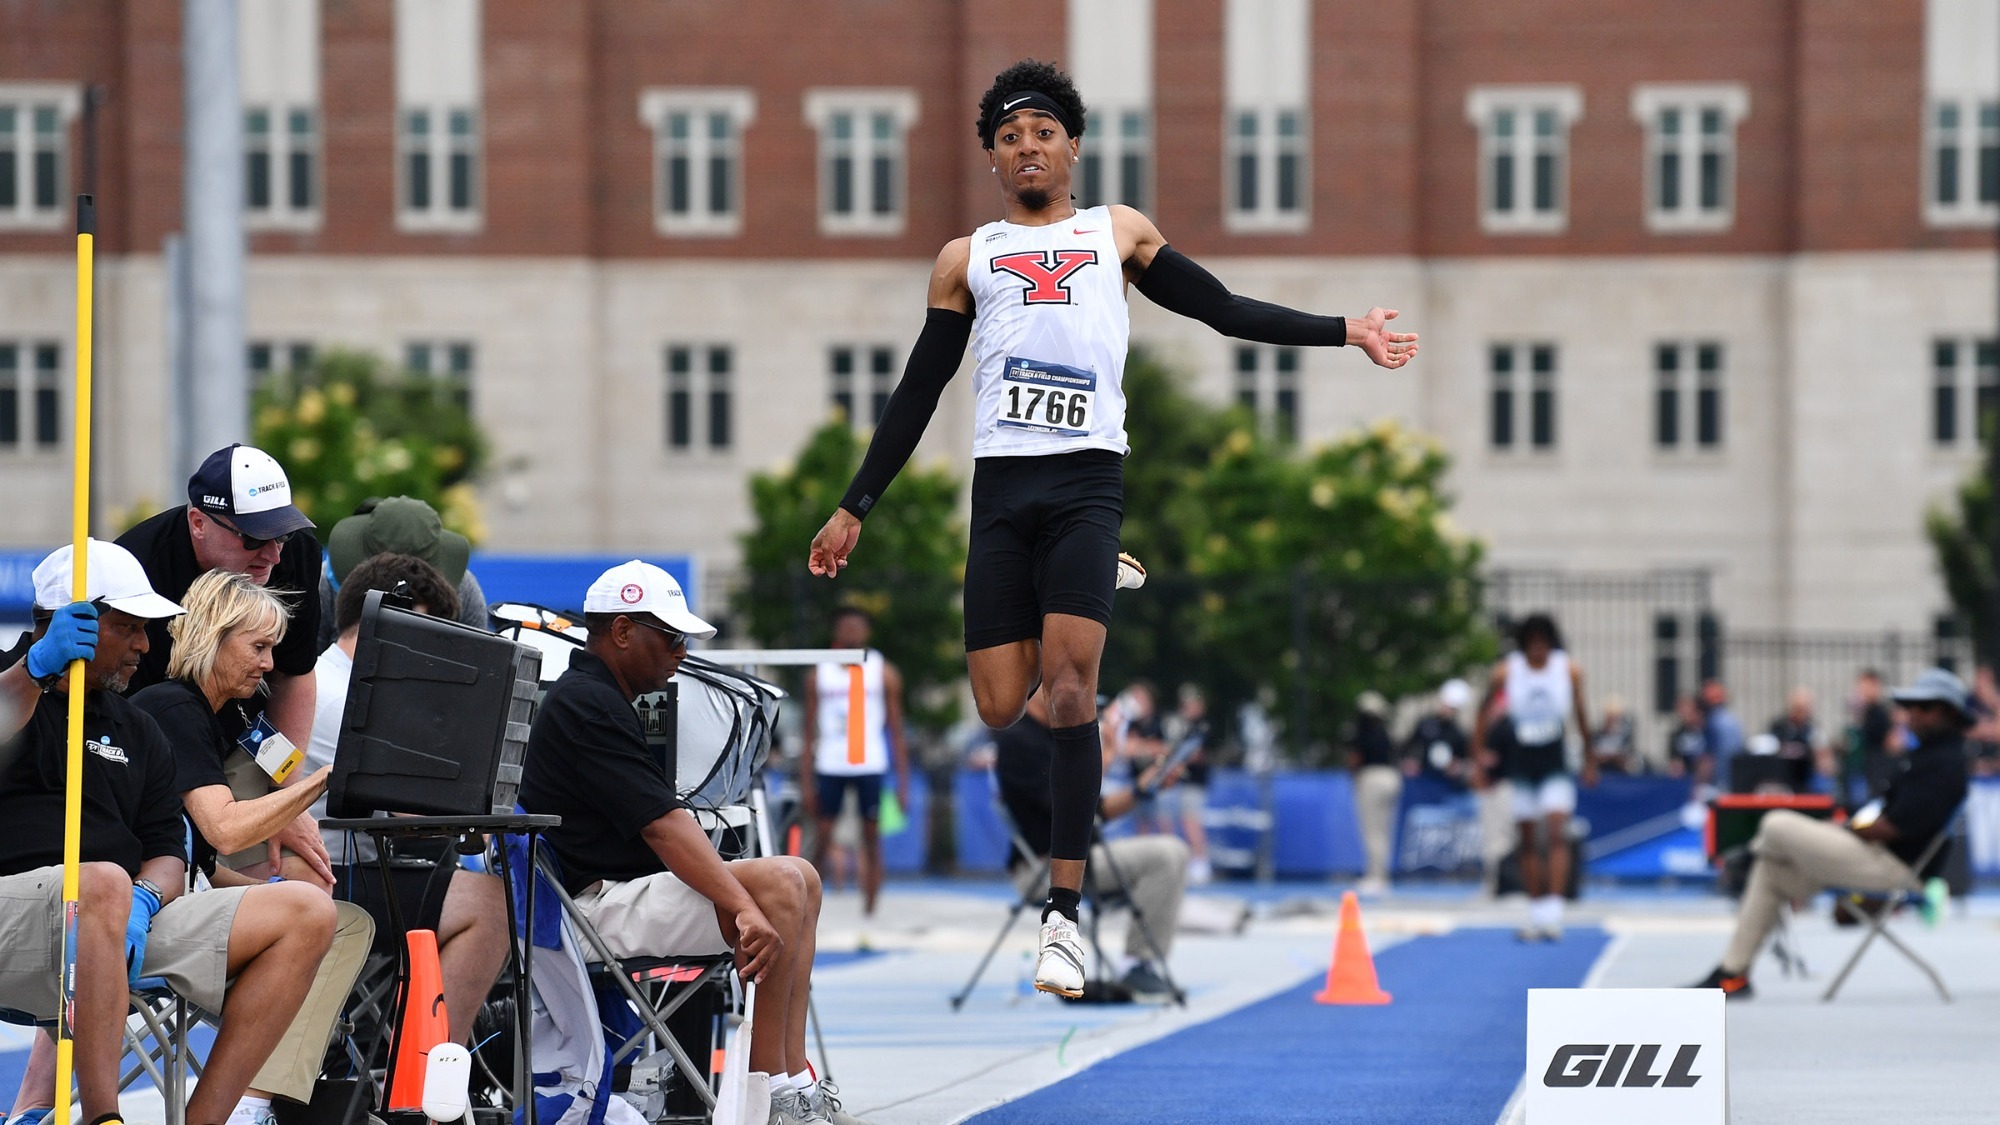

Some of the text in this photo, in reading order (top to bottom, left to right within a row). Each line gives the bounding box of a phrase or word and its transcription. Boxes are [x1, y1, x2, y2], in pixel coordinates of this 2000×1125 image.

[990, 250, 1098, 306] Y
[1006, 385, 1087, 428] 1766
[203, 495, 227, 506] GILL
[258, 483, 275, 494] TRACK
[1046, 930, 1072, 944] NIKE
[1543, 1044, 1702, 1088] GILL
